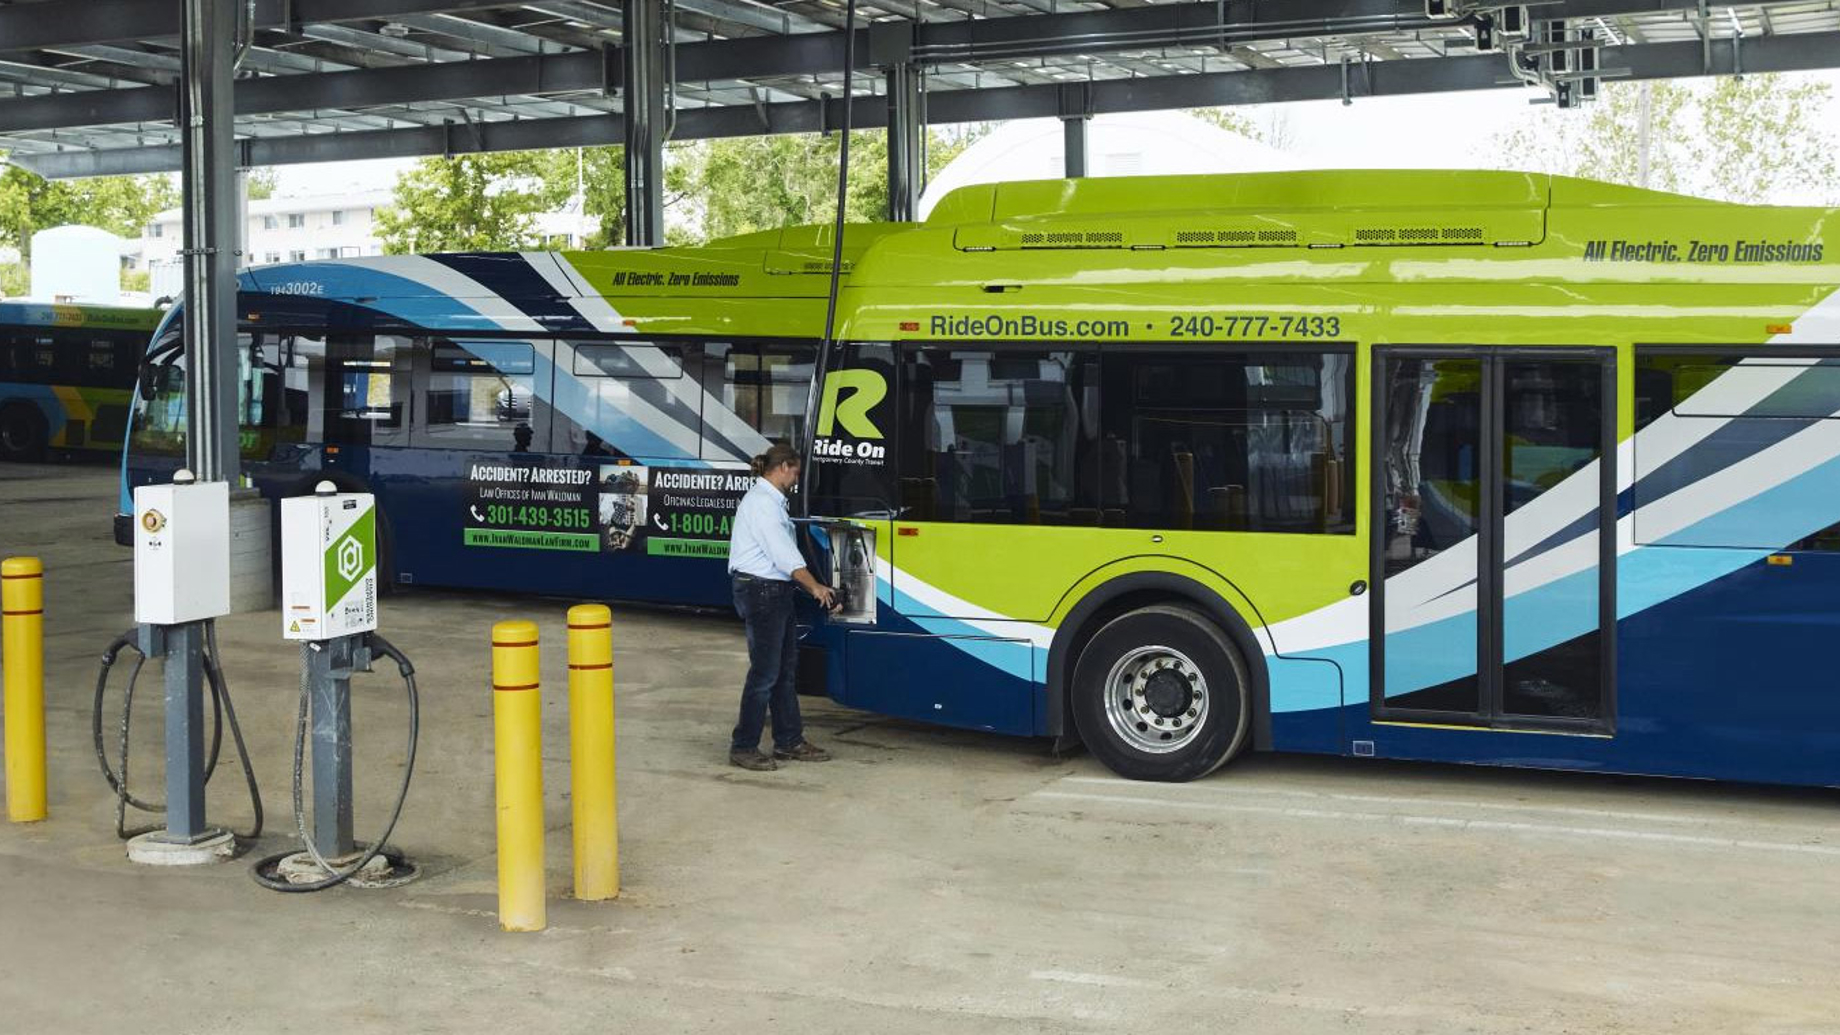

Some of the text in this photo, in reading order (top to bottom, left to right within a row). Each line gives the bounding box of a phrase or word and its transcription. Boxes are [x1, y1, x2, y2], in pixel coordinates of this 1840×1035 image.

[1583, 240, 1823, 262] All Electric. Zero Emissions
[613, 272, 740, 286] All Electric. Zero Emissions
[930, 315, 1341, 337] RideOnBus.com 240-777-7433
[813, 439, 885, 458] Ride On
[844, 457, 864, 466] County
[865, 458, 884, 466] Transit
[470, 464, 592, 485] ACCIDENT? ARRESTED?
[654, 471, 724, 490] ACCIDENTE?
[480, 487, 582, 502] LAW OFFICES OF IVAN WALDMAN
[663, 493, 695, 507] OFICINAS
[696, 496, 725, 509] LEGALES
[487, 504, 590, 528] 301-439-3515
